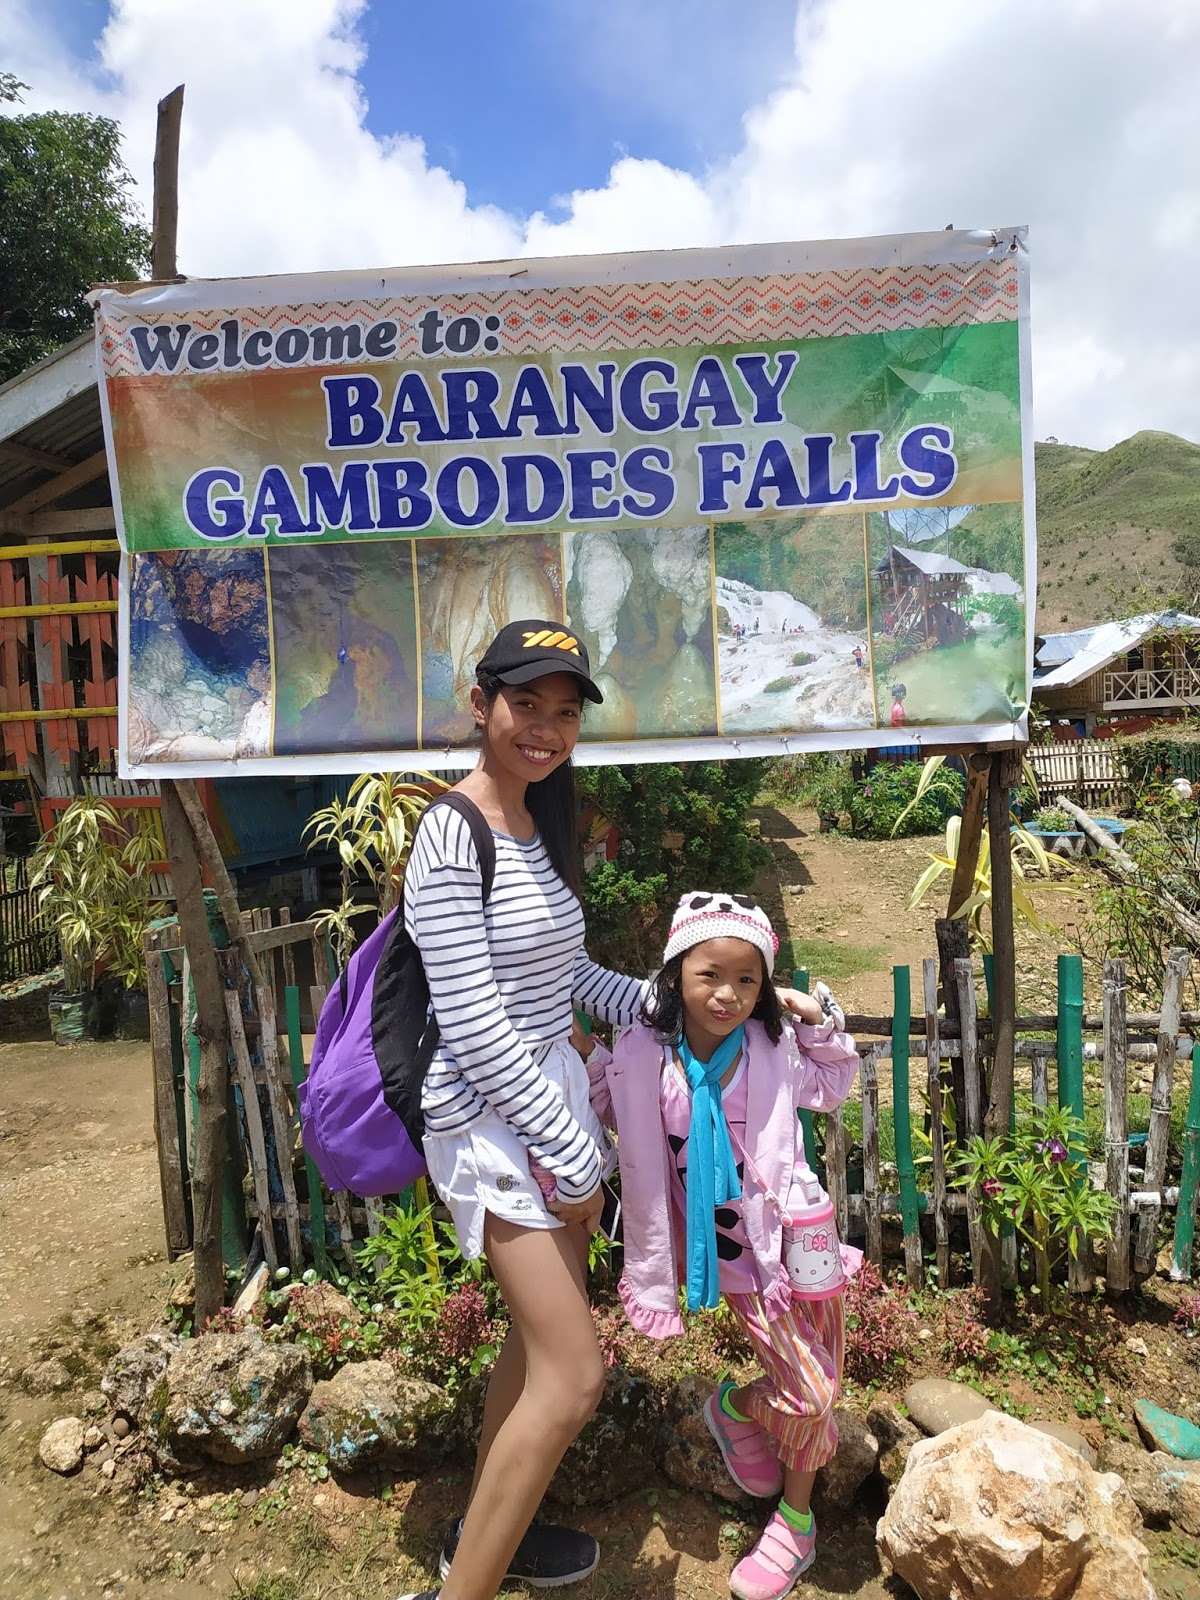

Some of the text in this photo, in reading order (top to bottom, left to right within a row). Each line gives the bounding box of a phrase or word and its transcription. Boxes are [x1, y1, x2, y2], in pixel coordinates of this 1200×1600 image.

[131, 310, 501, 373] Welcome to:
[323, 352, 798, 448] BARANGAY
[185, 425, 957, 540] GAMBODES FALLS
